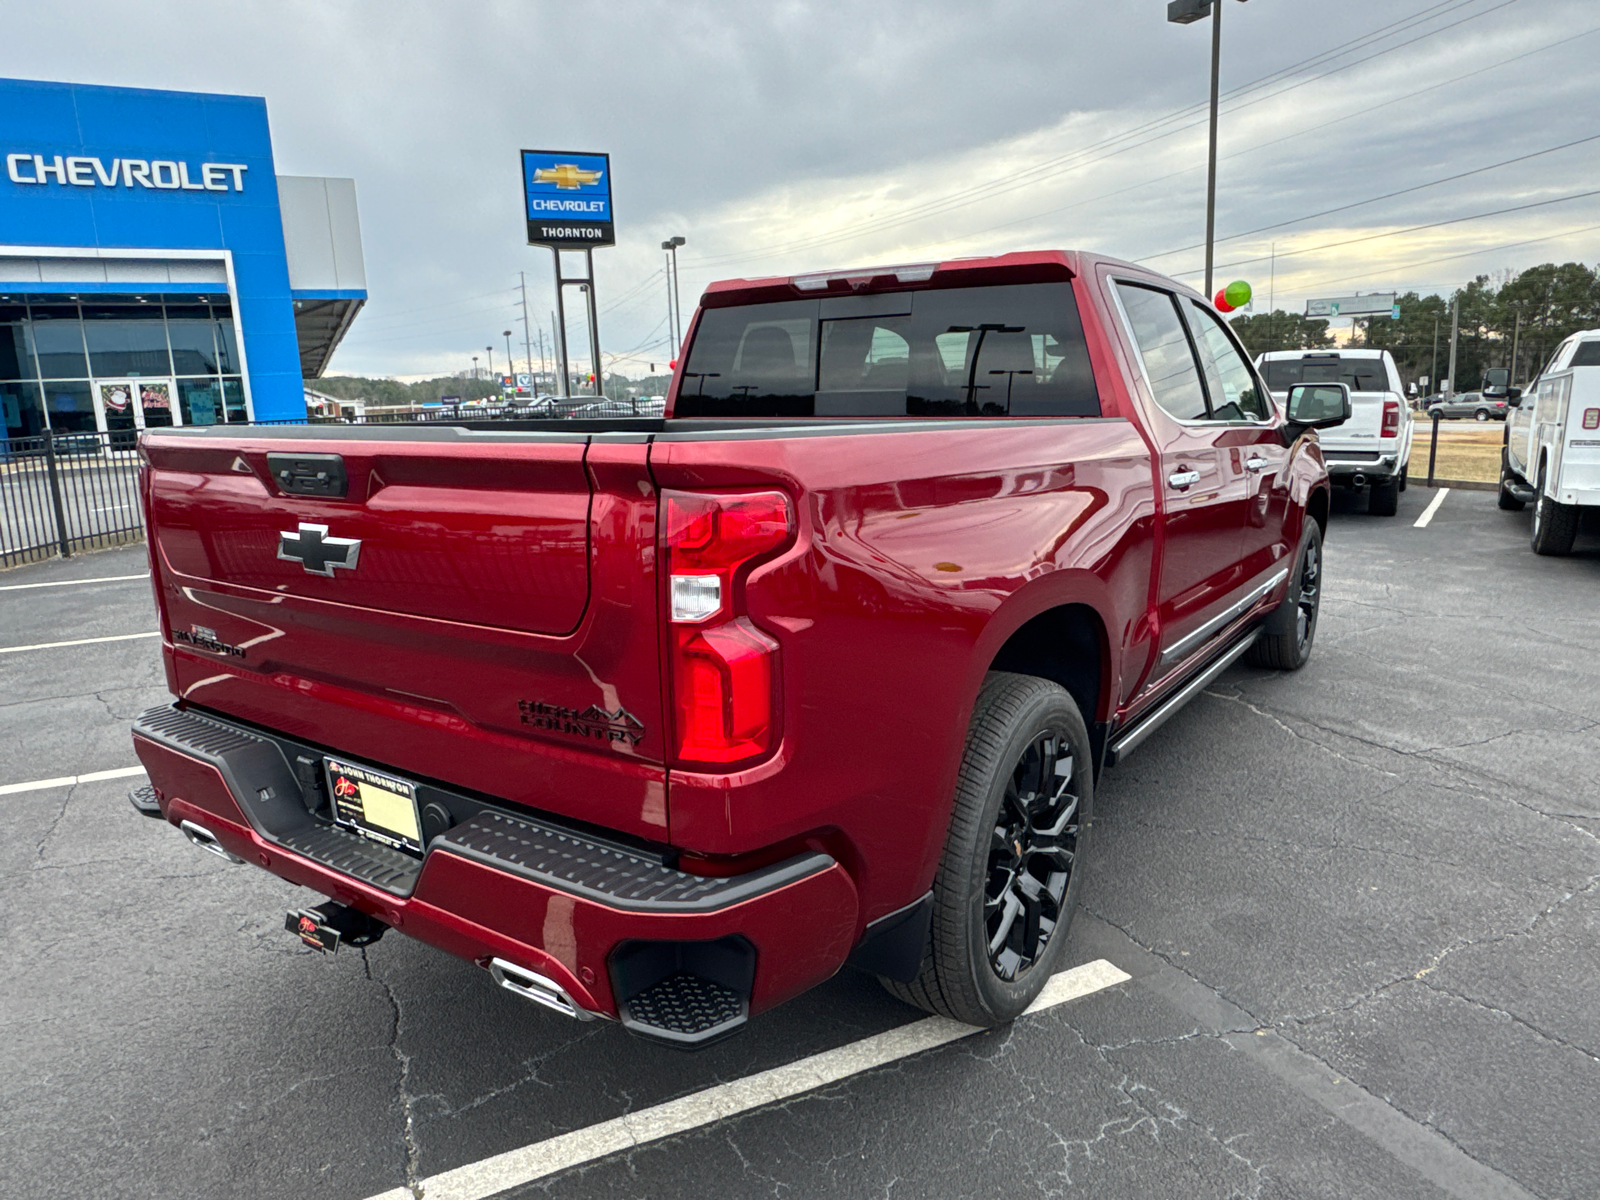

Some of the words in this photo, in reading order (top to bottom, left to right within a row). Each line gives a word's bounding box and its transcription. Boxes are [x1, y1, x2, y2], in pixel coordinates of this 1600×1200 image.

[6, 153, 248, 191] CHEVROLET
[532, 199, 605, 212] CHEVROLET
[541, 227, 602, 238] THORNTON
[518, 699, 578, 720] HIGH
[520, 715, 646, 745] COUNTRY
[343, 766, 365, 779] JOHN
